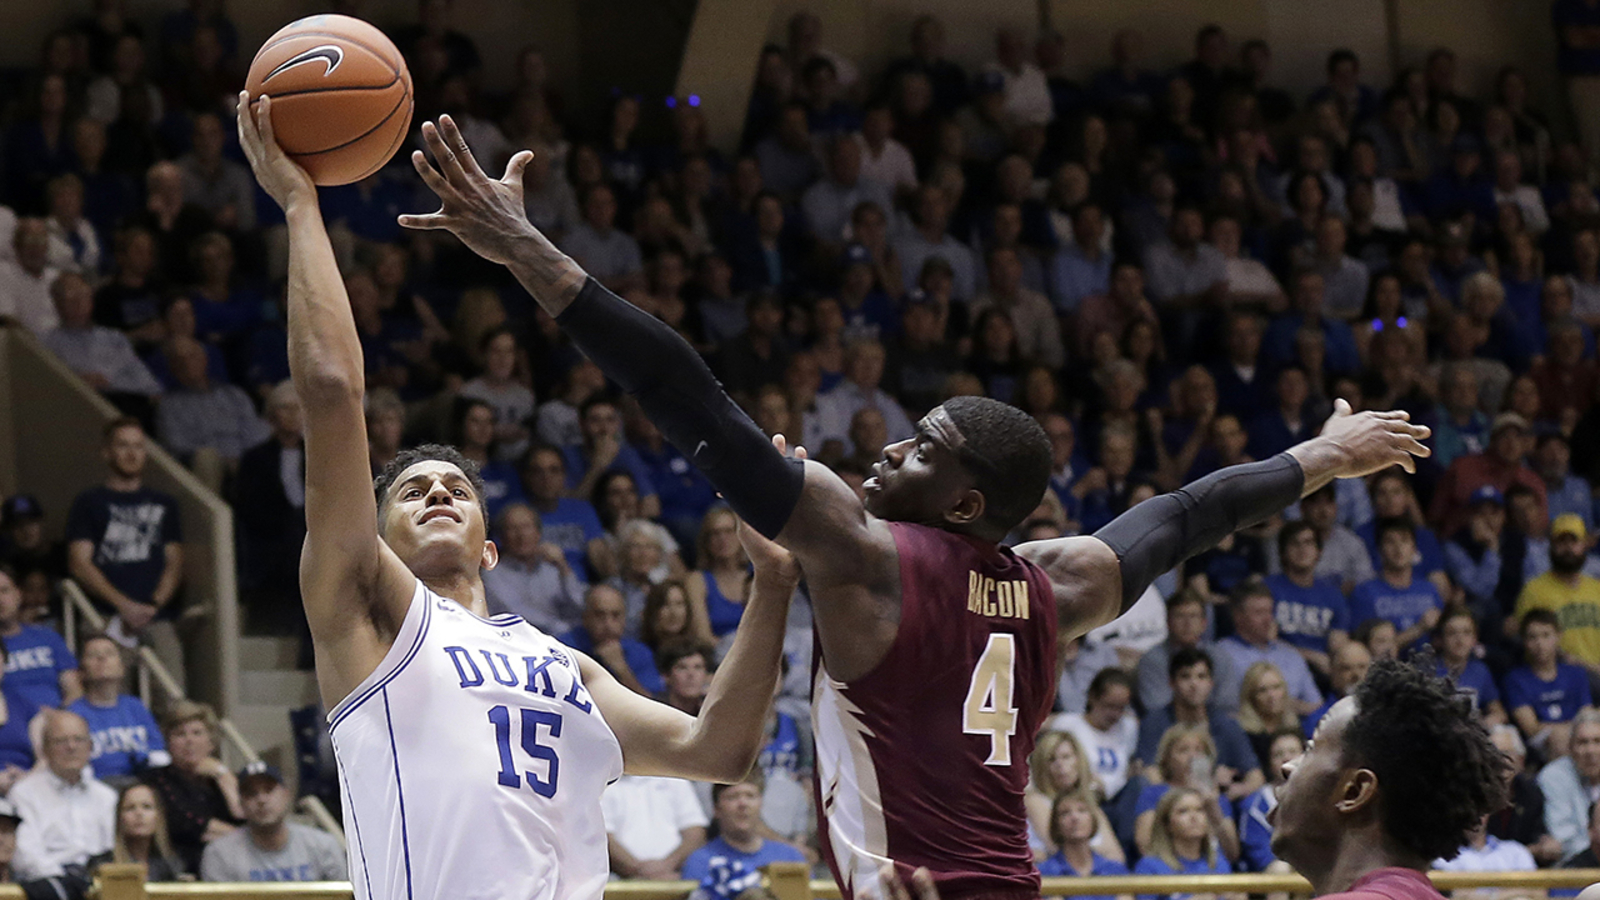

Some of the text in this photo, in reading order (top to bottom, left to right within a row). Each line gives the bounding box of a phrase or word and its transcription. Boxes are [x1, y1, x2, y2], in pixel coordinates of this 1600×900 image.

[967, 569, 1030, 620] BACON
[4, 645, 55, 674] UKE
[443, 646, 592, 715] DUKE
[963, 633, 1019, 766] 4
[487, 704, 562, 799] 15
